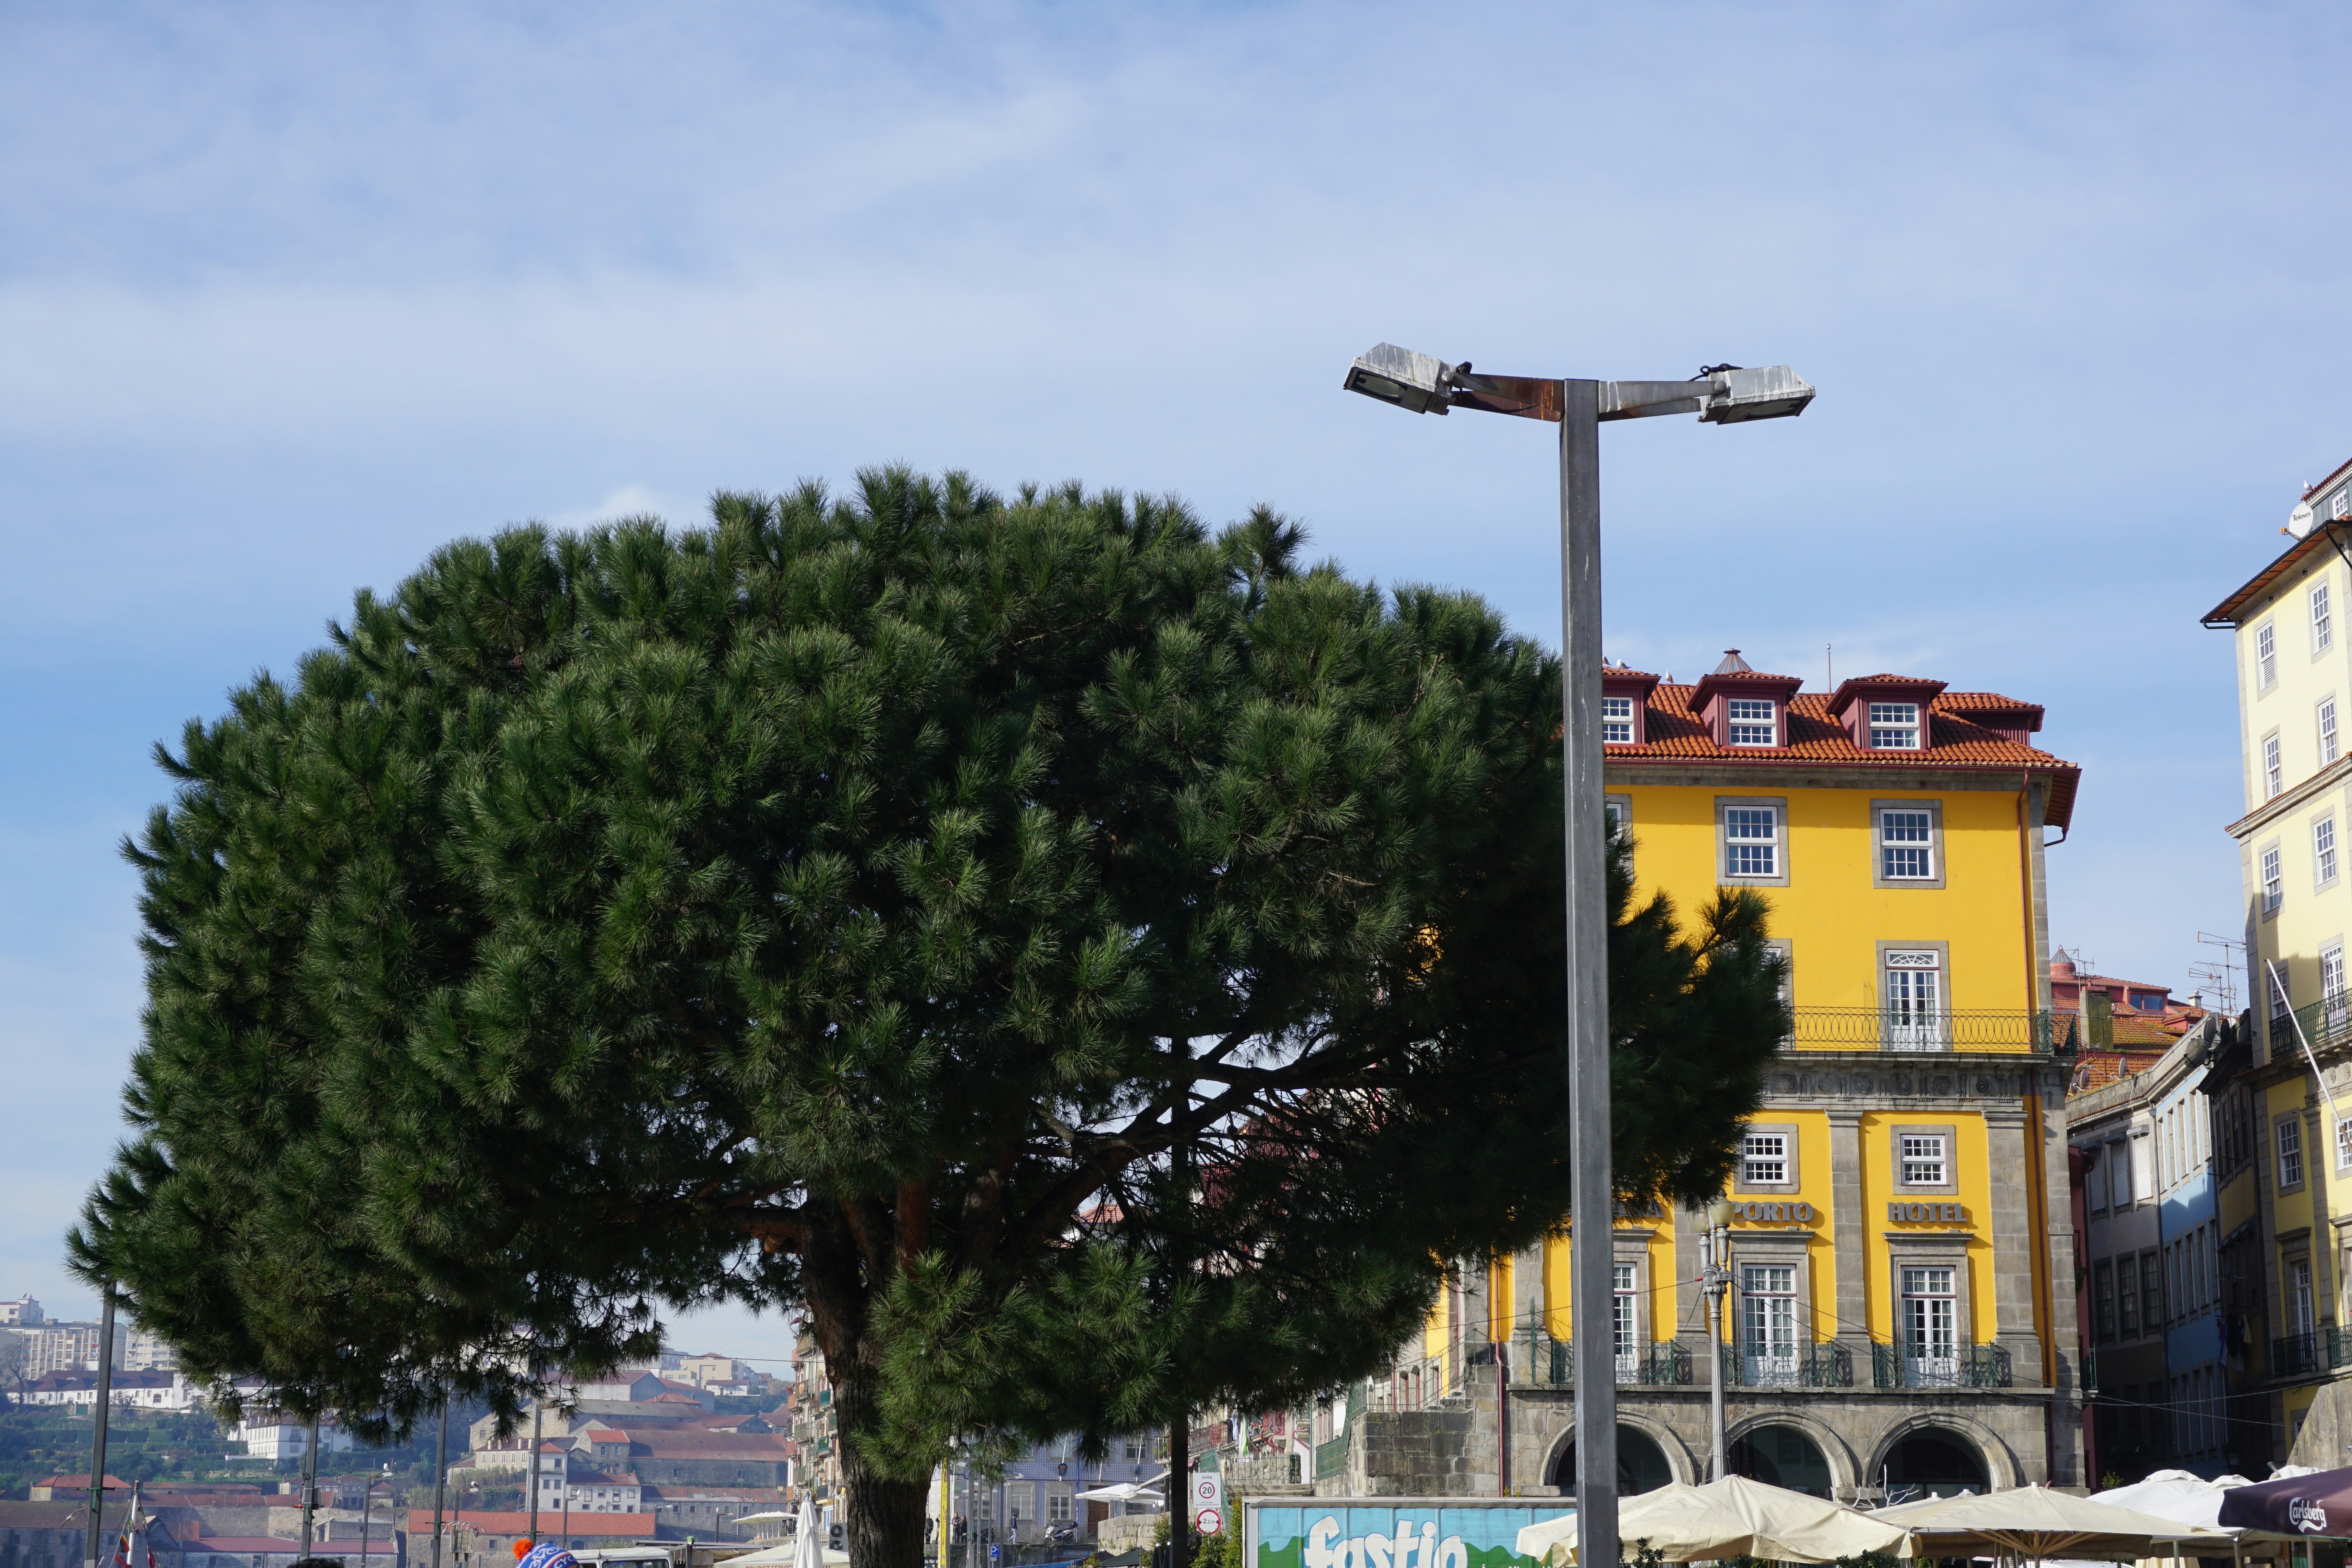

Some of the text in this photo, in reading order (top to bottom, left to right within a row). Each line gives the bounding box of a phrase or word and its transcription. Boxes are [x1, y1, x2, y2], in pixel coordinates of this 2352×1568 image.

[2292, 511, 2311, 521] Televes
[1887, 1202, 1967, 1222] HOTEL
[2289, 1497, 2327, 1528] Carlsberg
[991, 1546, 997, 1556] P
